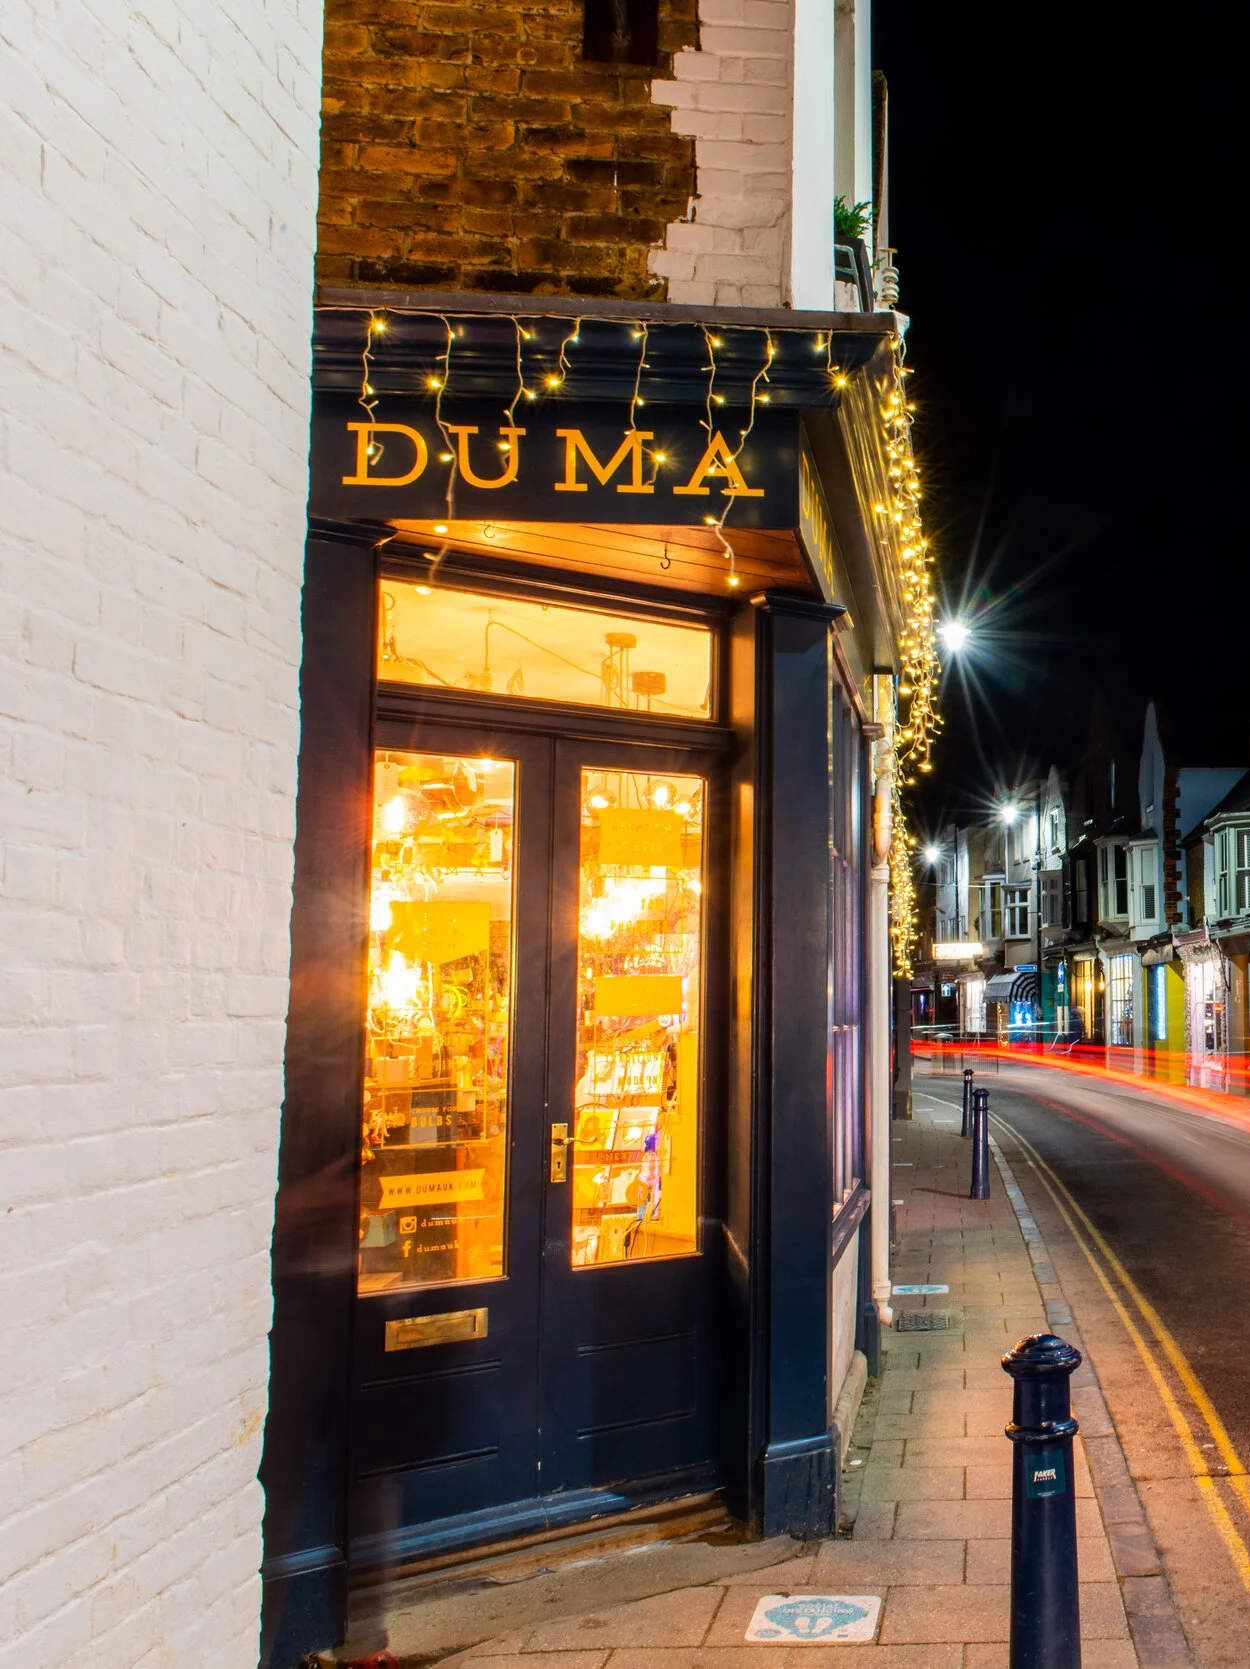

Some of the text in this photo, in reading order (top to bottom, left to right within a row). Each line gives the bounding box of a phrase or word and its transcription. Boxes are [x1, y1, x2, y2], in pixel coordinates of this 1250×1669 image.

[342, 422, 765, 497] DUMA
[802, 450, 835, 596] DUMA
[410, 1114, 453, 1129] BULBS
